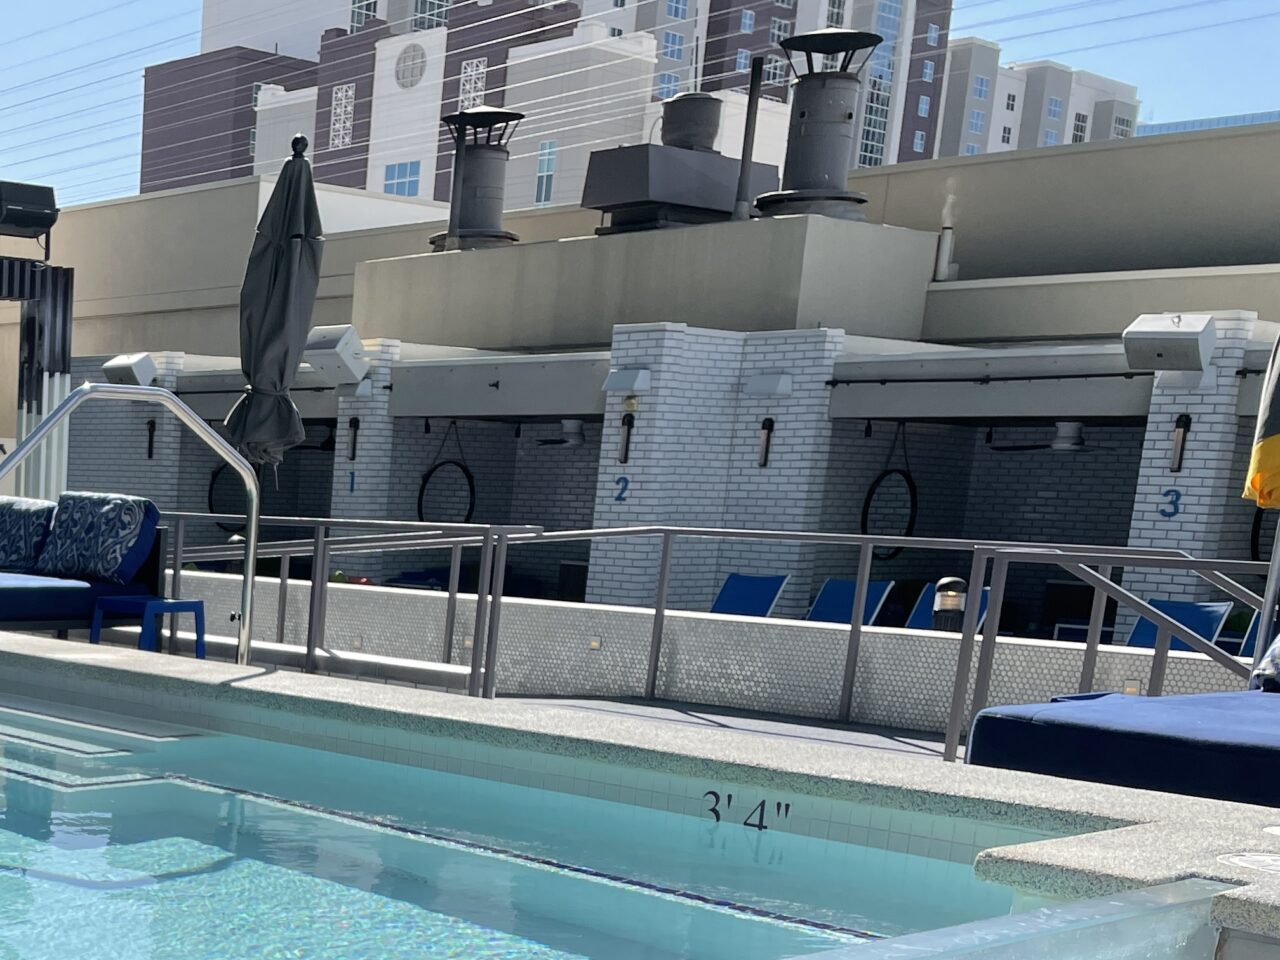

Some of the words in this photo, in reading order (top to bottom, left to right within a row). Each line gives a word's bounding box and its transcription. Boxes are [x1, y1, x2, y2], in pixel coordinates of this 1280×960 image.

[349, 471, 356, 494] 1
[614, 476, 630, 502] 2
[1160, 489, 1182, 518] 3
